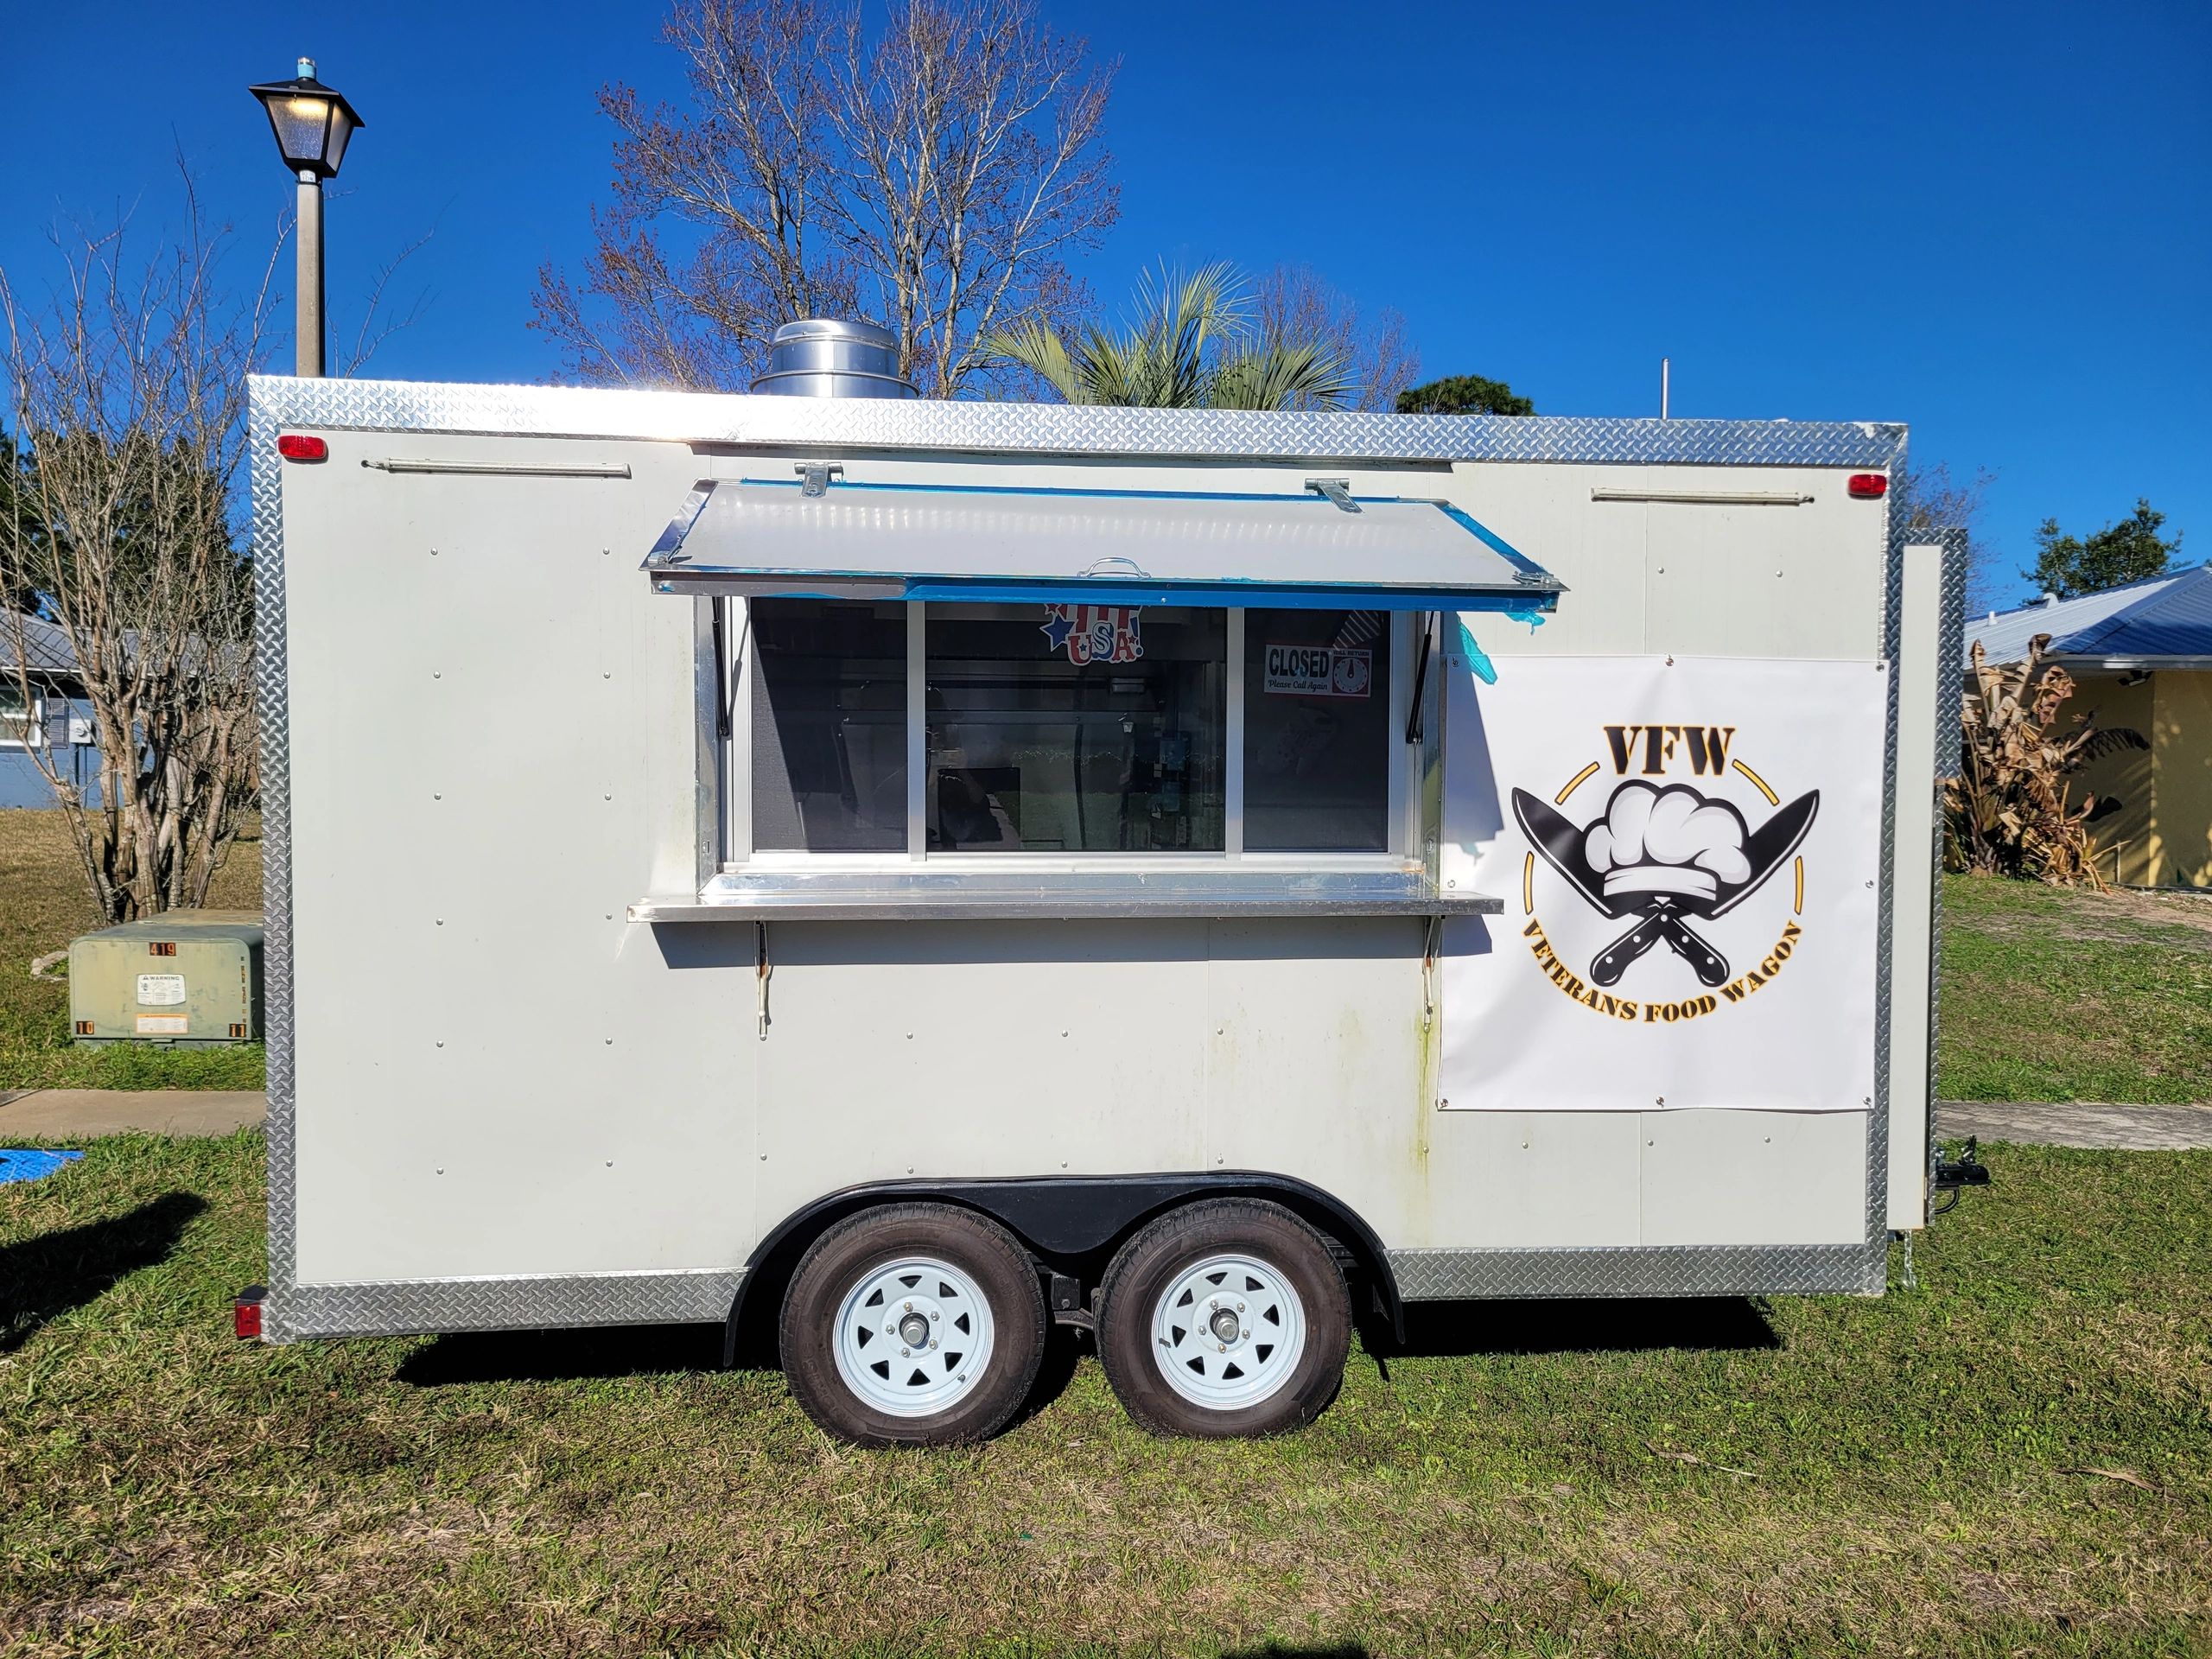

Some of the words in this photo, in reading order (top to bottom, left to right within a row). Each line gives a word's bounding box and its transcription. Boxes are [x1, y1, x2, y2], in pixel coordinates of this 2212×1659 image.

[1268, 648, 1330, 678] CLOSED
[1268, 678, 1292, 690] Please
[1293, 679, 1306, 690] Call
[1306, 680, 1328, 692] Again
[1603, 725, 1736, 776] VFW
[150, 943, 175, 956] 419
[1522, 918, 1638, 1021] VETERANS
[1643, 995, 1717, 1024] FOOD
[1719, 919, 1802, 1005] WAGON
[77, 1021, 93, 1034] 10
[231, 1023, 246, 1037] 11
